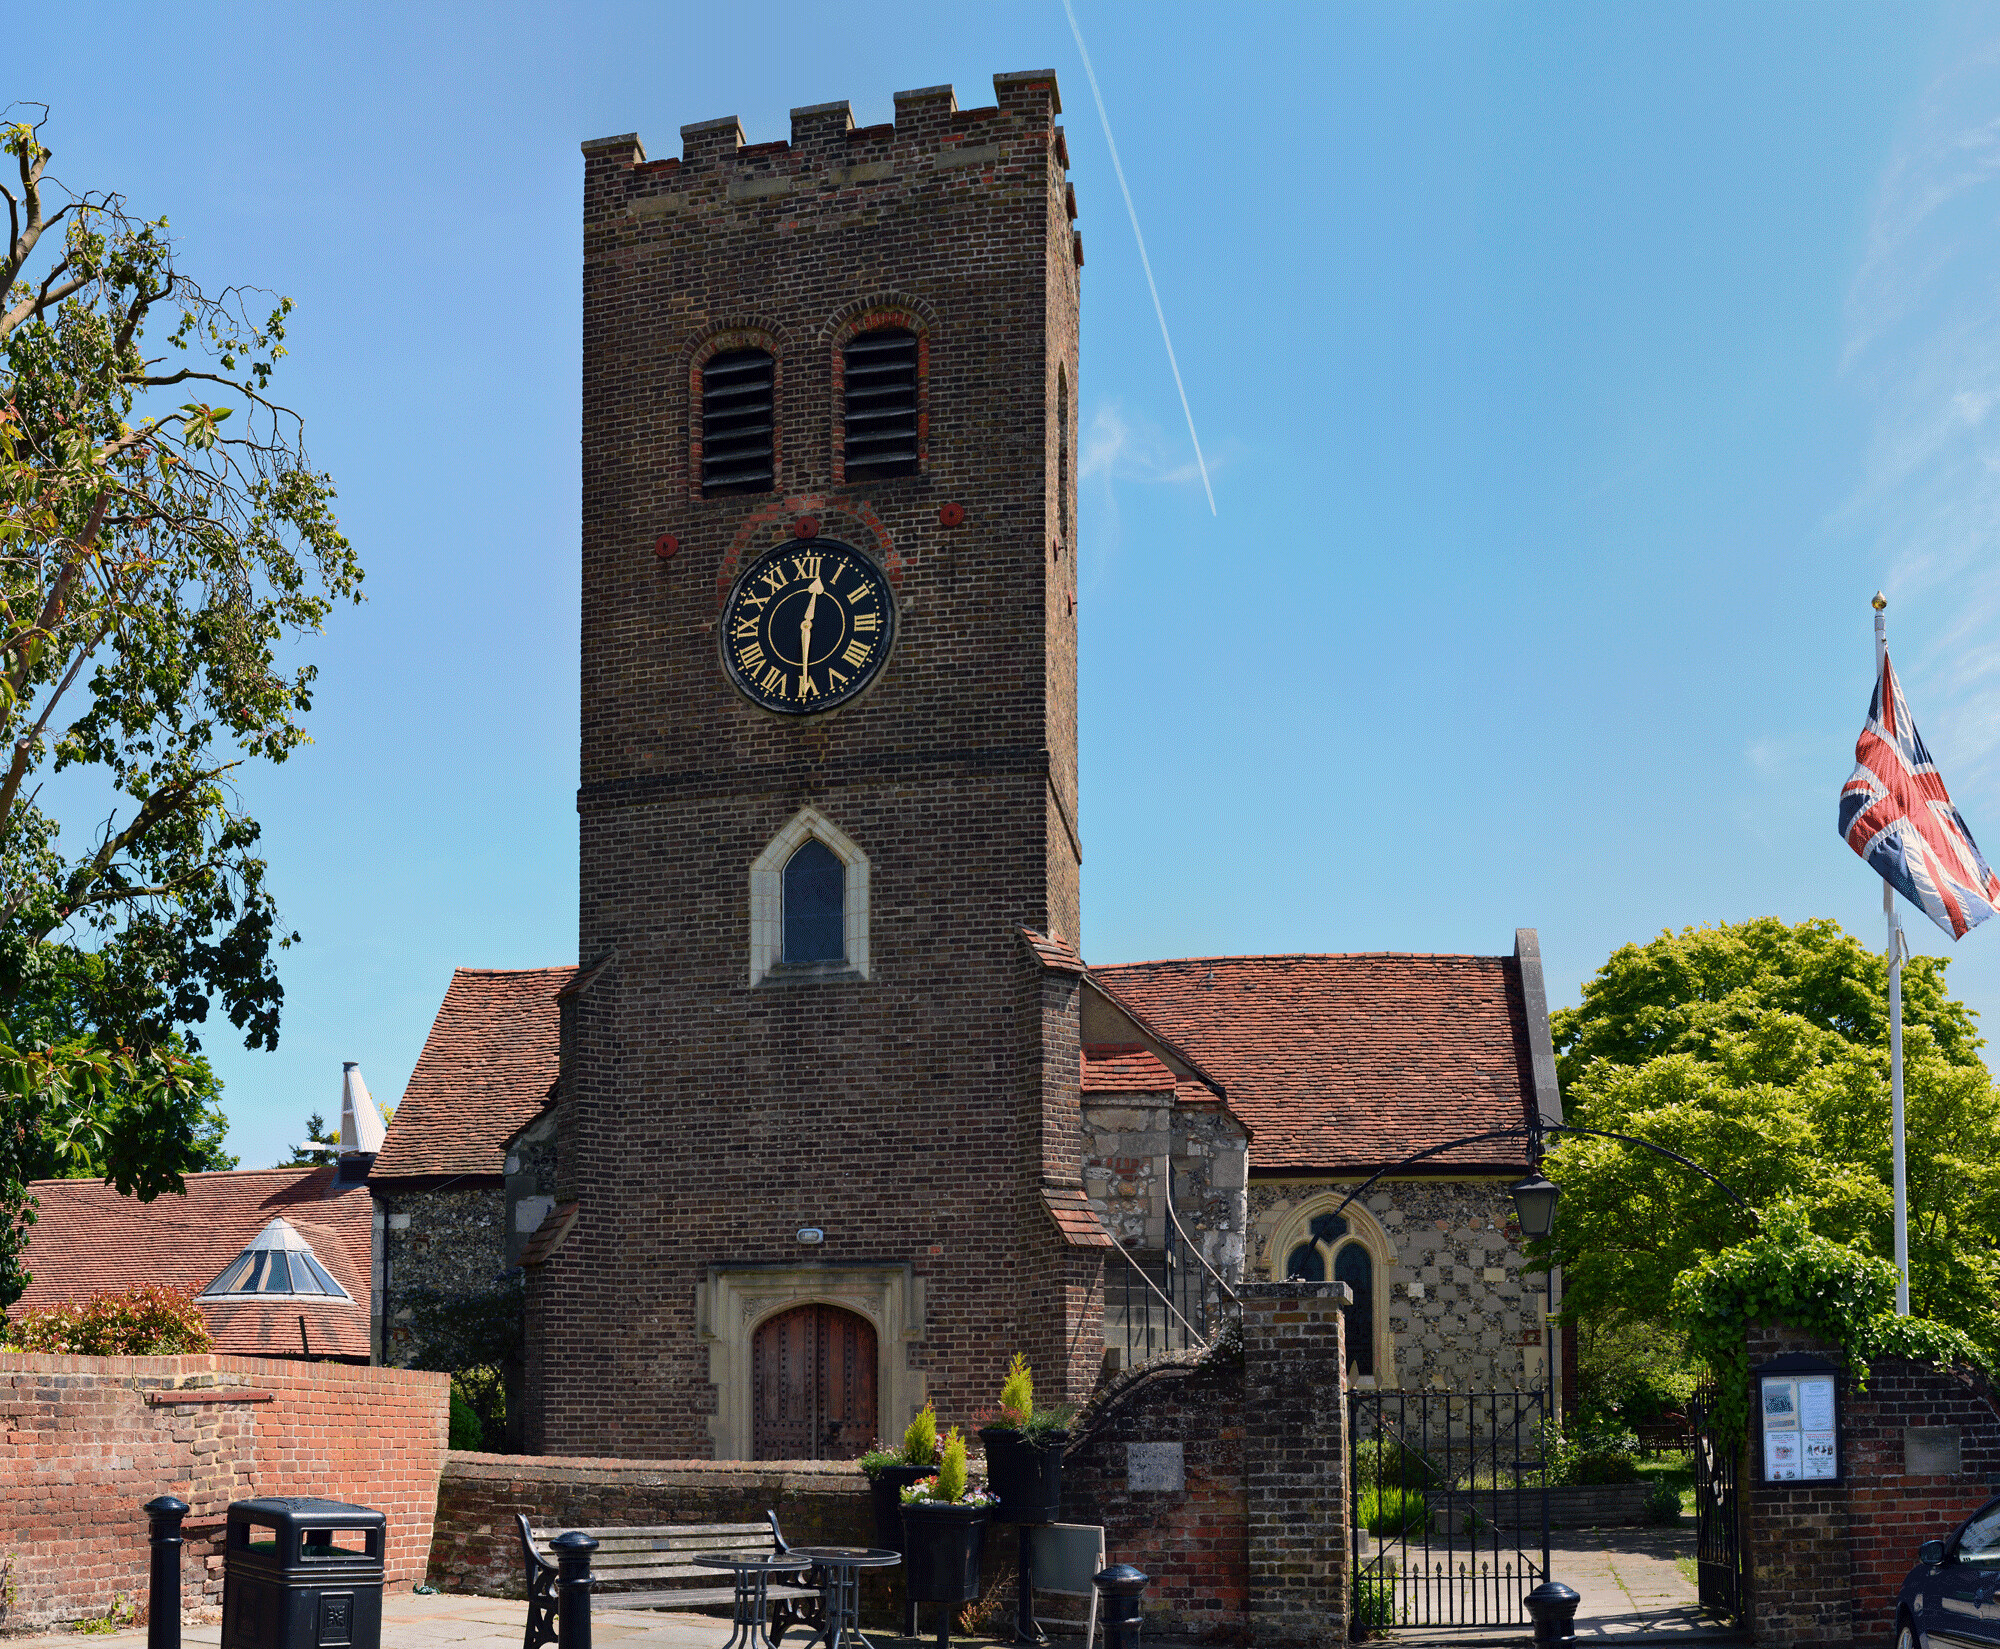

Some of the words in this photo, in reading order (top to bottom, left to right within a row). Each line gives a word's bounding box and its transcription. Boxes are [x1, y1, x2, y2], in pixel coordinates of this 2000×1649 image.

[761, 565, 789, 596] XI
[792, 556, 823, 581] XII
[829, 563, 846, 585] I
[743, 590, 771, 612] X
[846, 583, 870, 605] II
[737, 614, 761, 639] IX
[853, 612, 876, 632] III
[739, 641, 767, 679] VIII
[841, 638, 872, 668] IIII
[760, 665, 787, 697] VII
[828, 667, 849, 691] V
